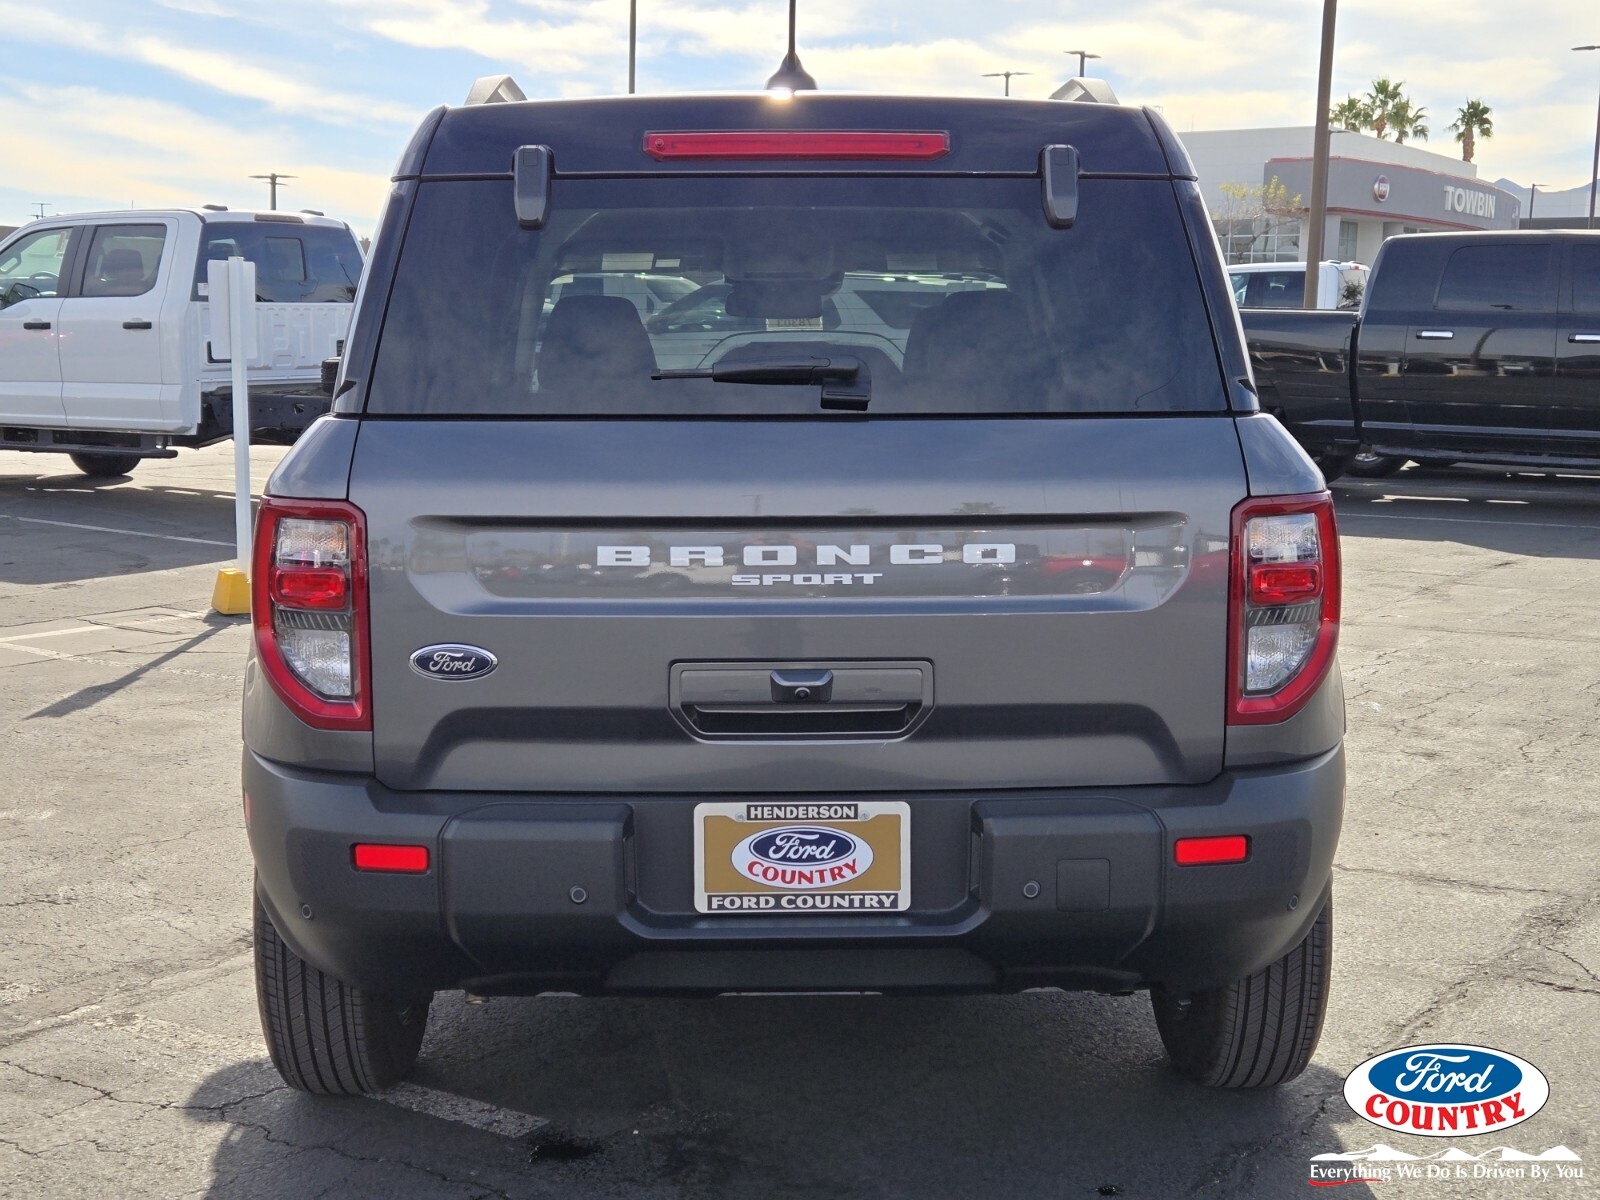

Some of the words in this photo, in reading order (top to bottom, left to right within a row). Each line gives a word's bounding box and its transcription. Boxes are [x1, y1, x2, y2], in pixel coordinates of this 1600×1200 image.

[1444, 185, 1496, 219] TOWBIN
[597, 543, 1016, 567] BRONCO
[731, 572, 883, 586] SPORT
[428, 651, 476, 672] Ford
[750, 805, 855, 819] HENDERSON
[768, 832, 837, 860] Ford
[747, 858, 858, 885] COUNTRY
[711, 896, 776, 909] FORD
[780, 894, 896, 908] COUNTRY
